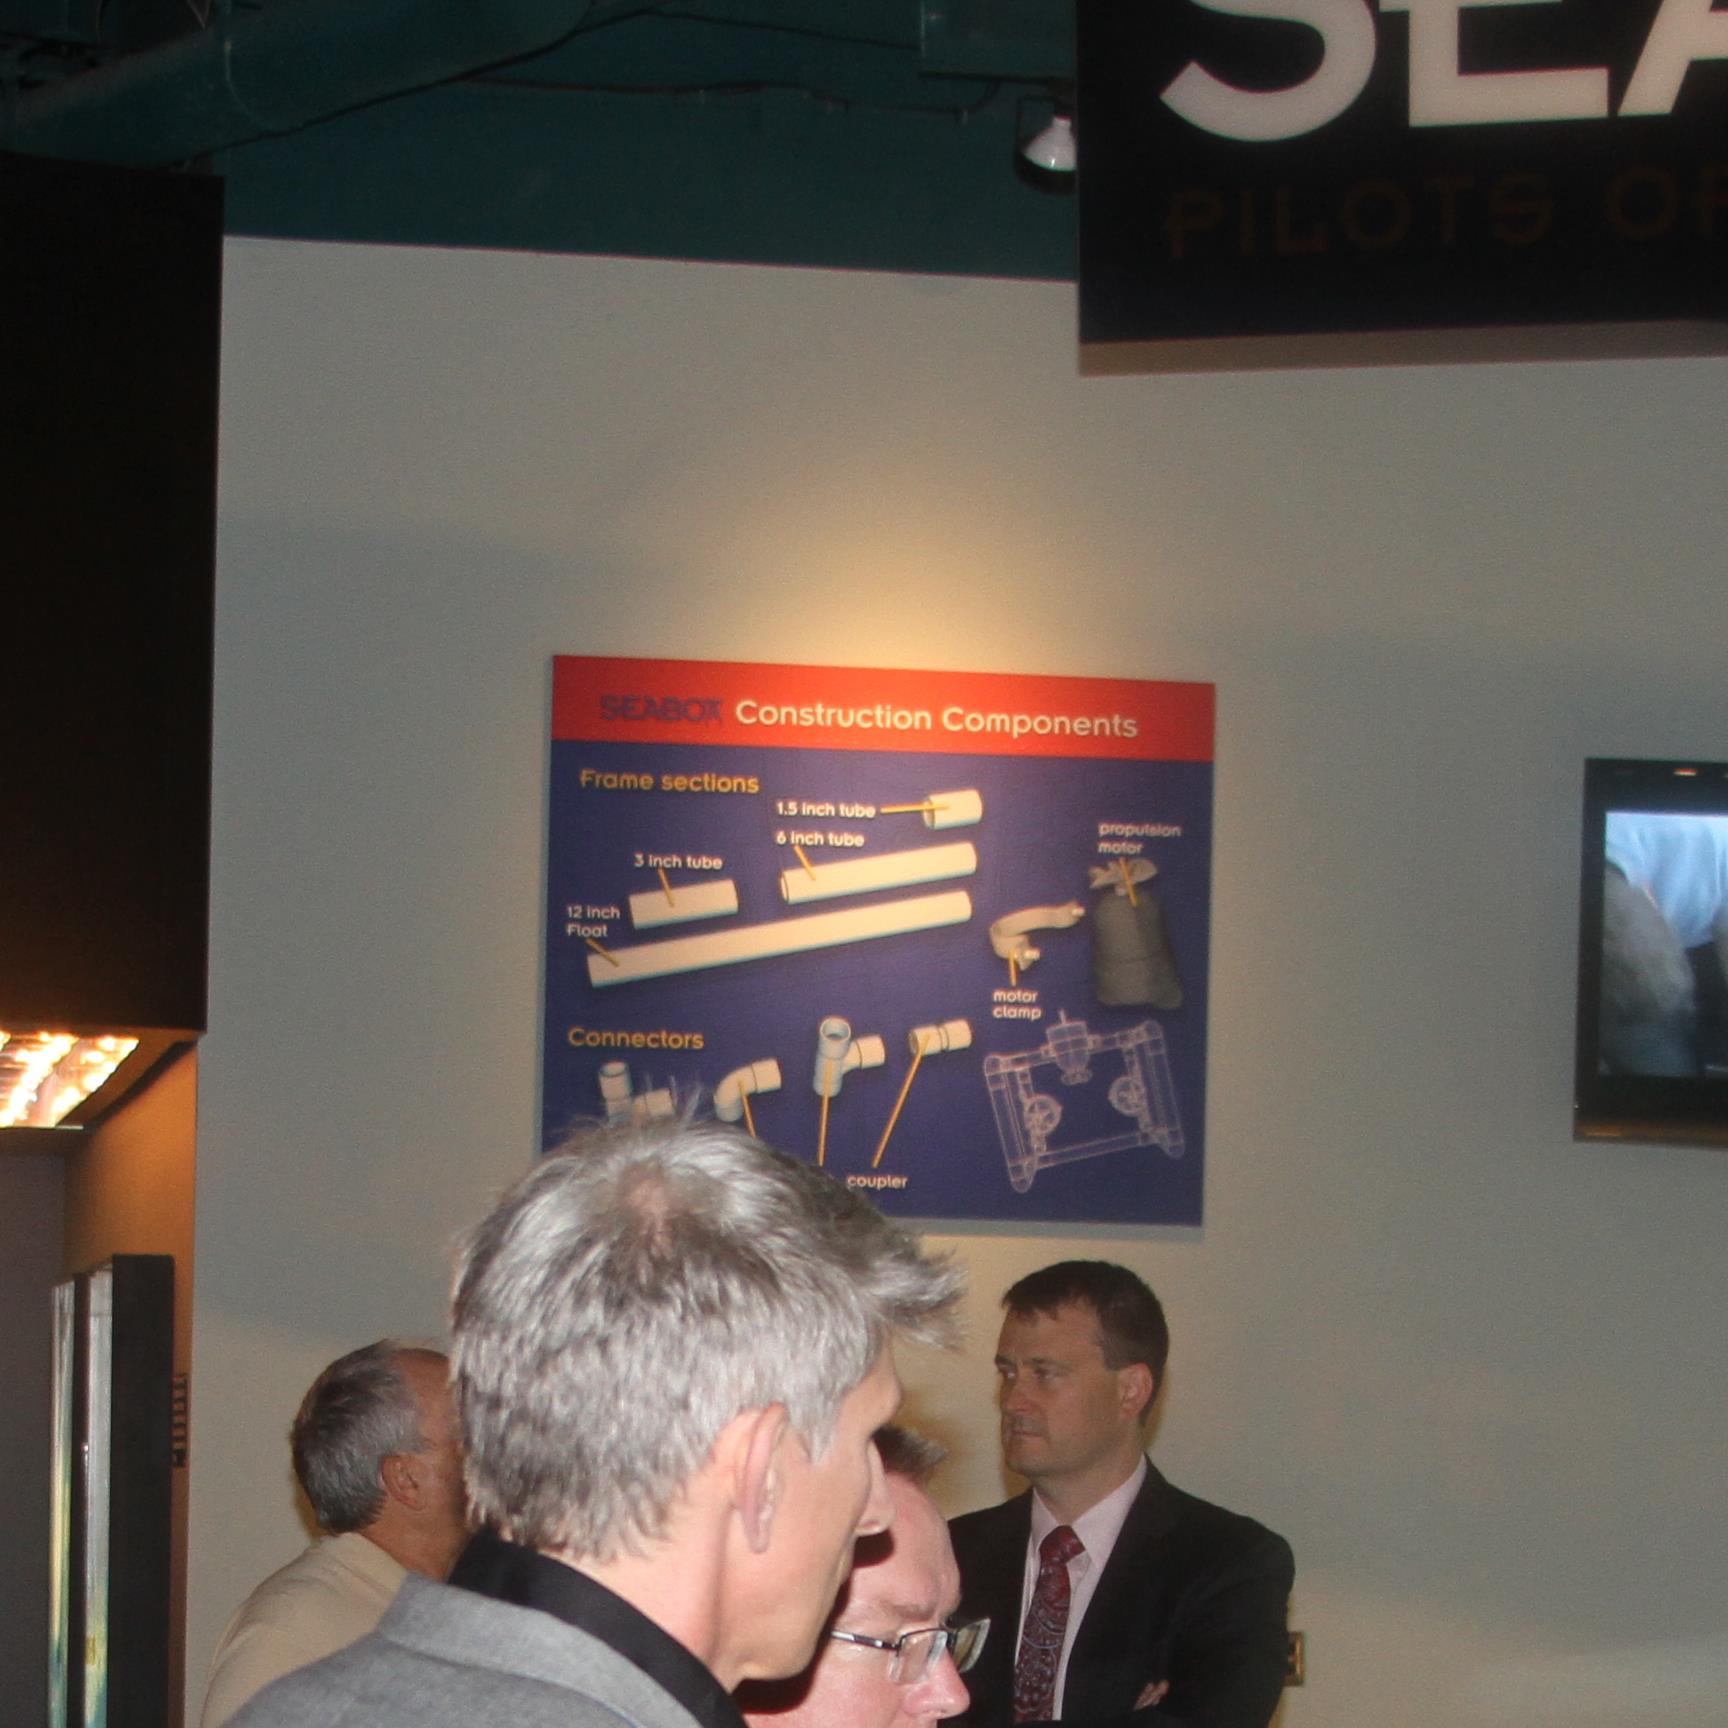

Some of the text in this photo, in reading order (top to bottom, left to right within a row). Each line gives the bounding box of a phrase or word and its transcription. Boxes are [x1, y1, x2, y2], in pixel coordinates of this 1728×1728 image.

[735, 700, 932, 729] Construction
[942, 706, 1138, 739] Components
[579, 769, 760, 794] Frame sections
[776, 801, 876, 819] 1.5 inch tube
[1098, 822, 1182, 837] propulsion
[776, 831, 865, 847] 6 inch tube
[1098, 840, 1143, 854] motor
[633, 853, 723, 870] 3 inch tube
[567, 905, 621, 920] 12 inch
[567, 923, 608, 938] Float
[992, 990, 1039, 1004] motor
[992, 1006, 1042, 1022] clamp
[568, 1026, 705, 1050] Connectors
[847, 1175, 908, 1191] coupler
